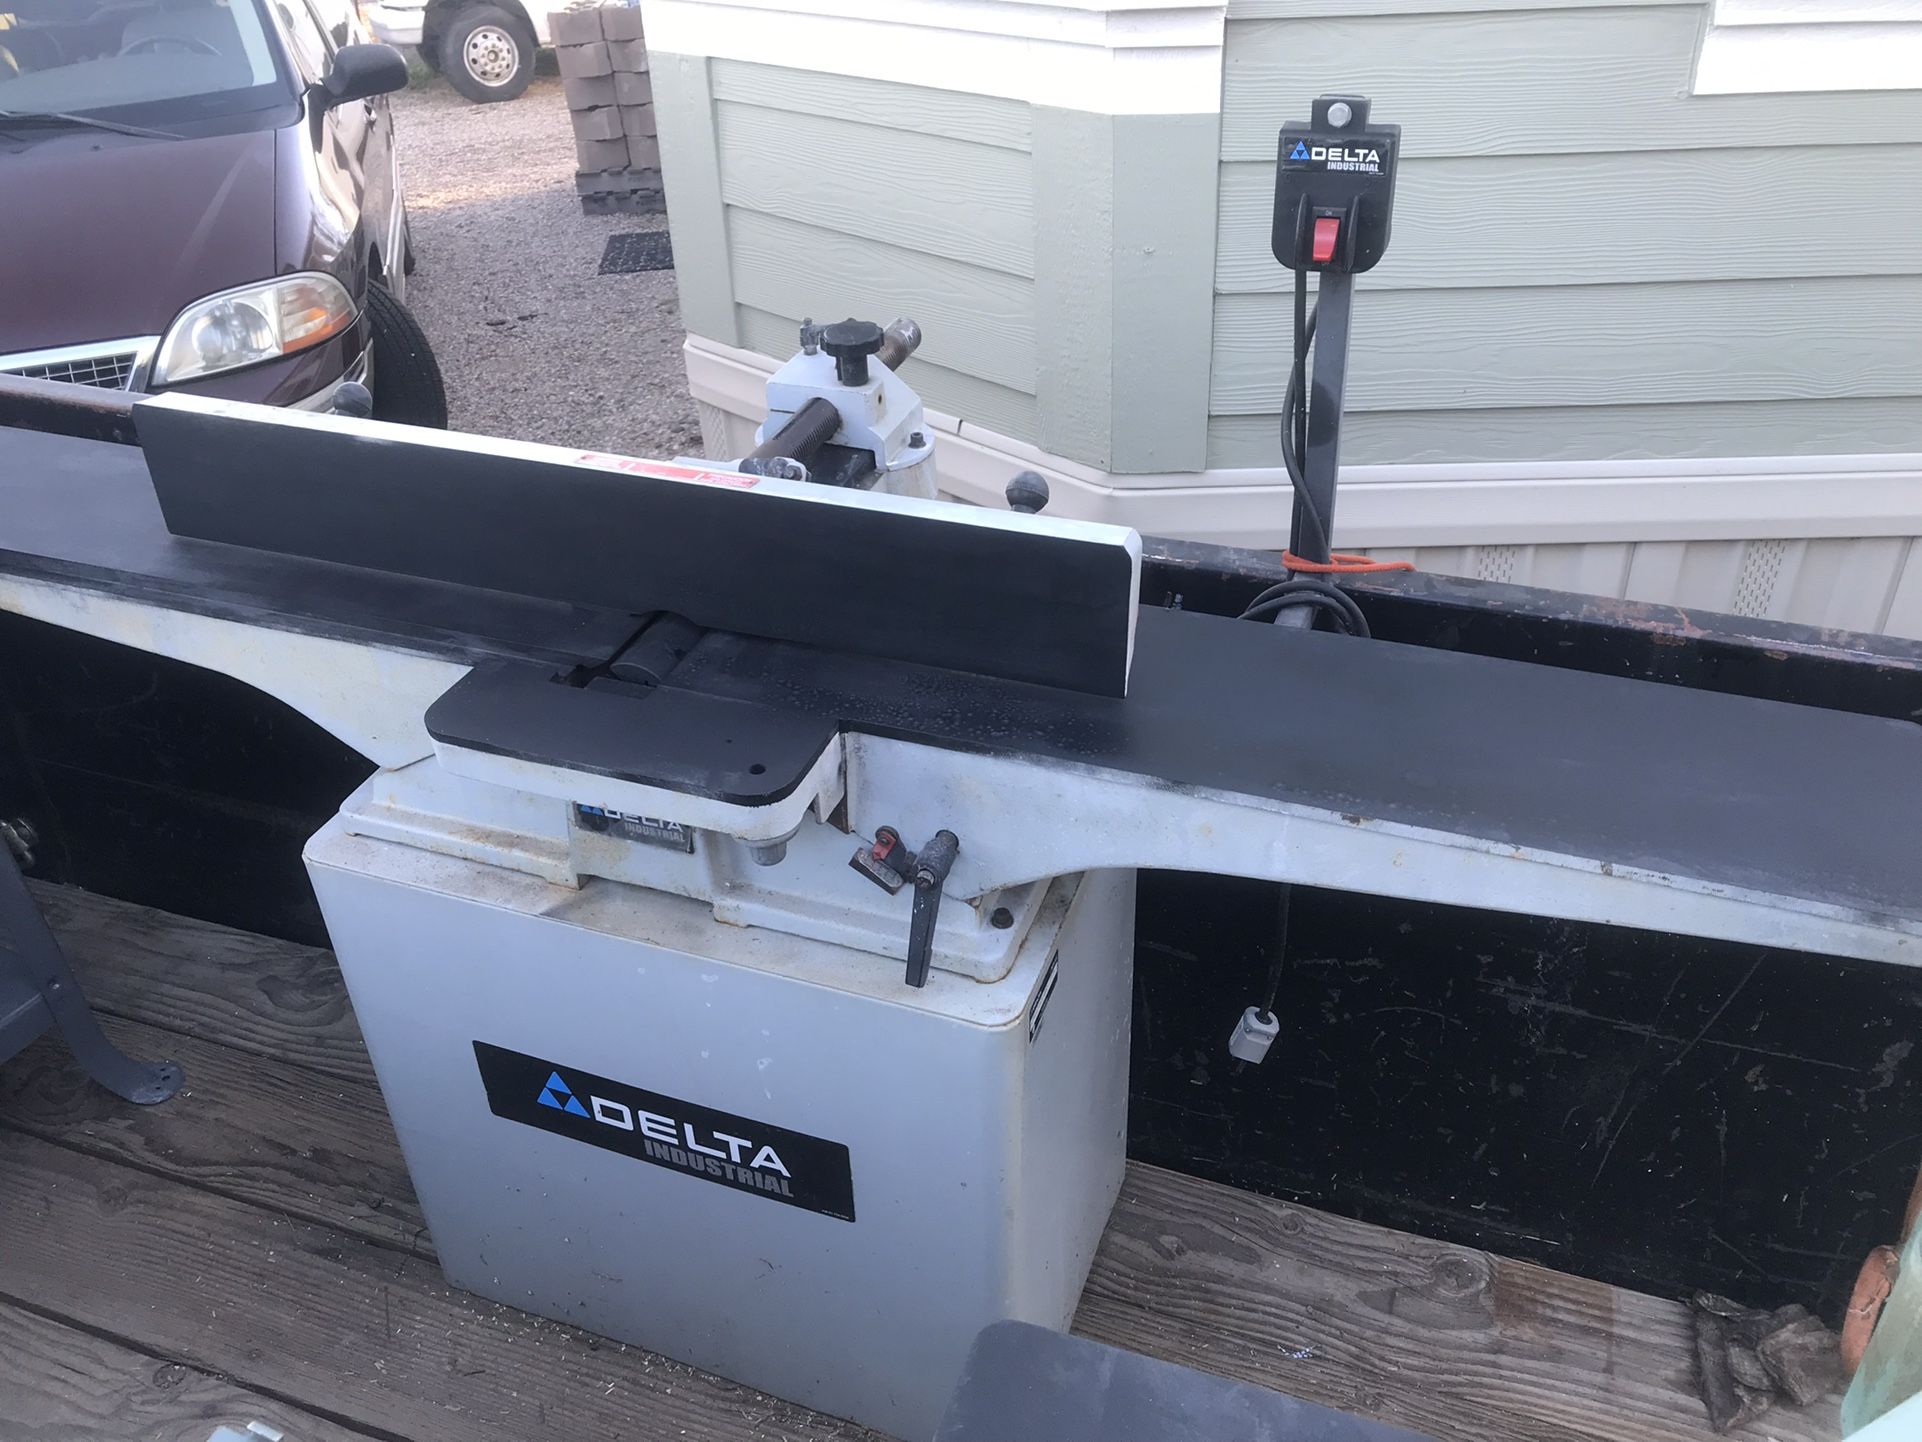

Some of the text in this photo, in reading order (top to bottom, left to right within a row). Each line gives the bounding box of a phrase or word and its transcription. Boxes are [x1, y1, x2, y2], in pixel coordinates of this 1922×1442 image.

[1311, 147, 1381, 163] DELTA
[1327, 161, 1380, 172] INDUSTRIAL
[624, 822, 686, 842] INDUSTRIAL
[590, 1094, 792, 1179] DELTA
[643, 1138, 795, 1198] INDUSTRIAL
